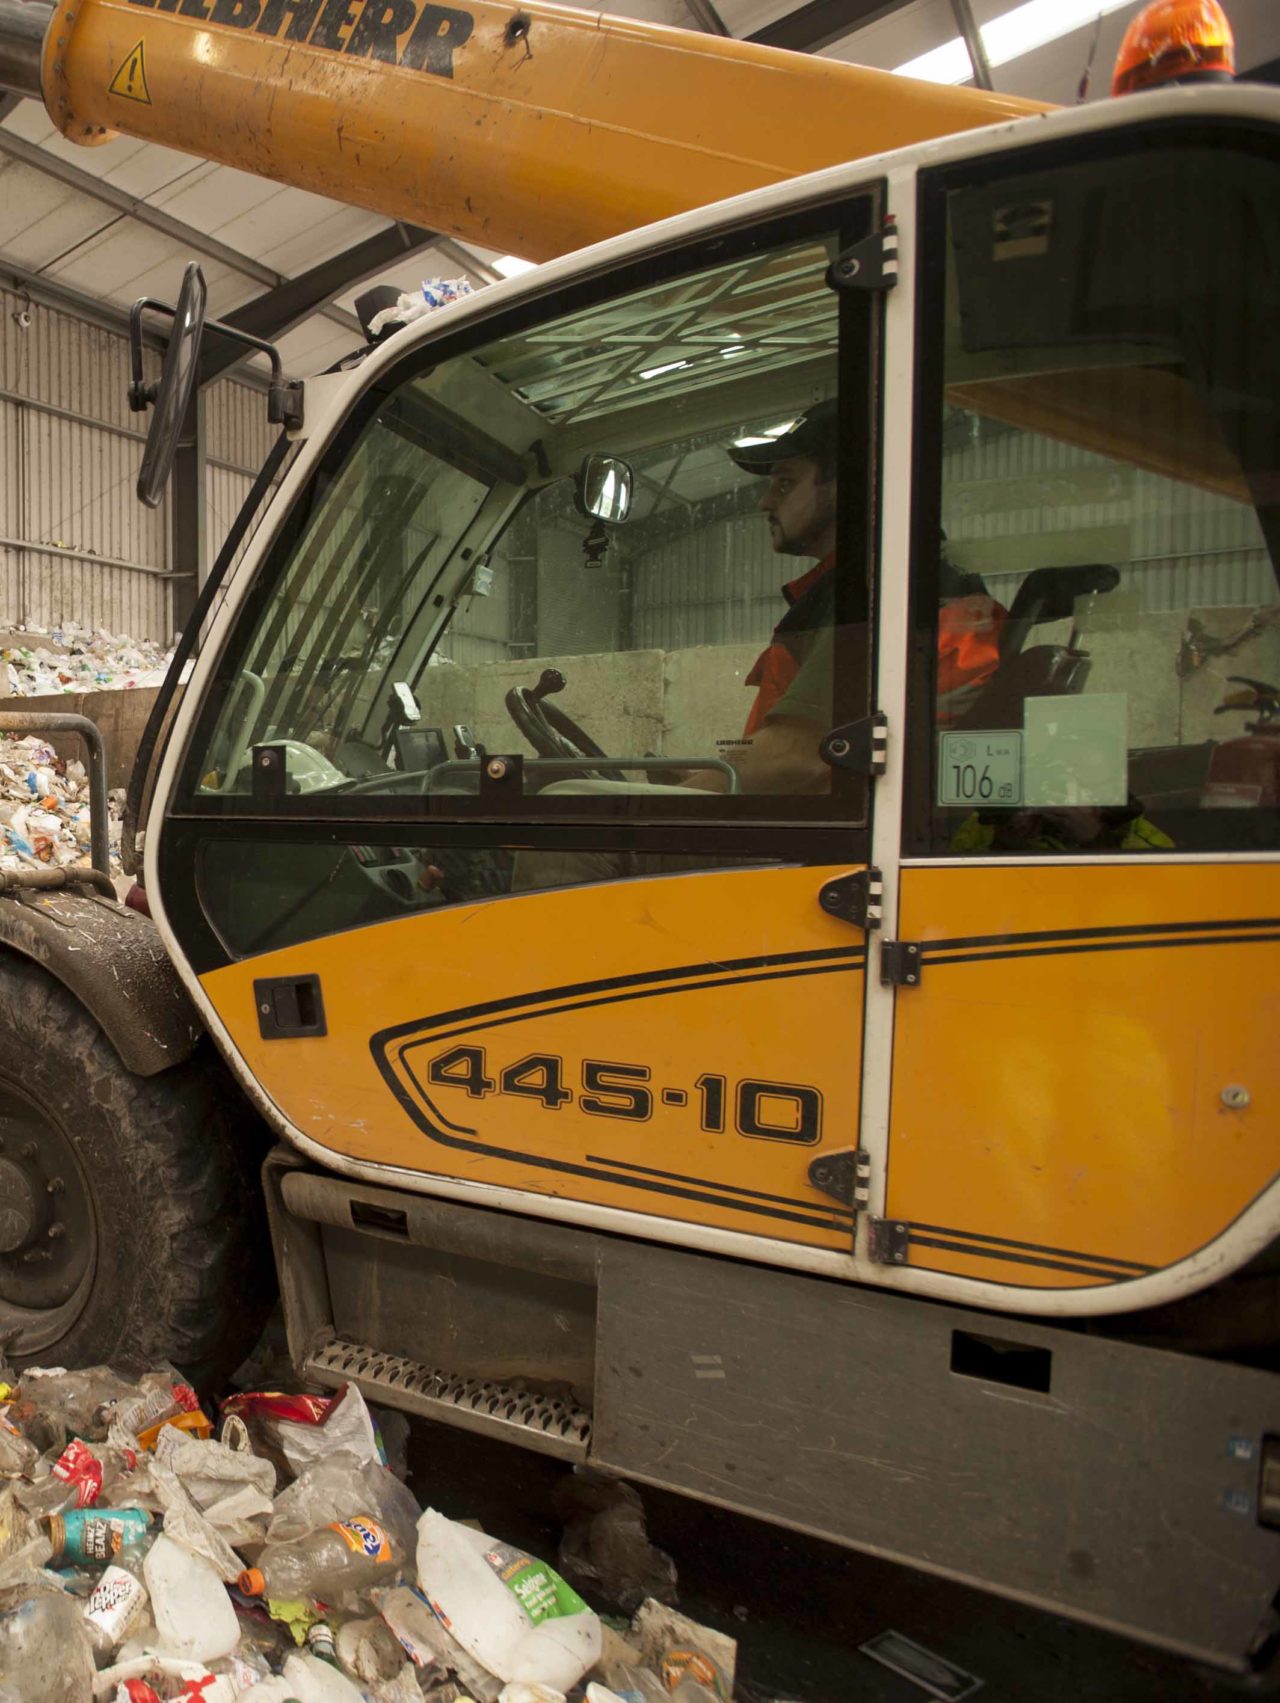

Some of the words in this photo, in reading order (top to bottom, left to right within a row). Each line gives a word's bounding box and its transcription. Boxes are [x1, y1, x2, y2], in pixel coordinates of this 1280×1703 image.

[127, 0, 474, 80] BHERR
[952, 764, 993, 799] 106
[427, 1044, 824, 1148] 445-10
[86, 1525, 95, 1554] HEINZ
[95, 1521, 107, 1560] BEANZ
